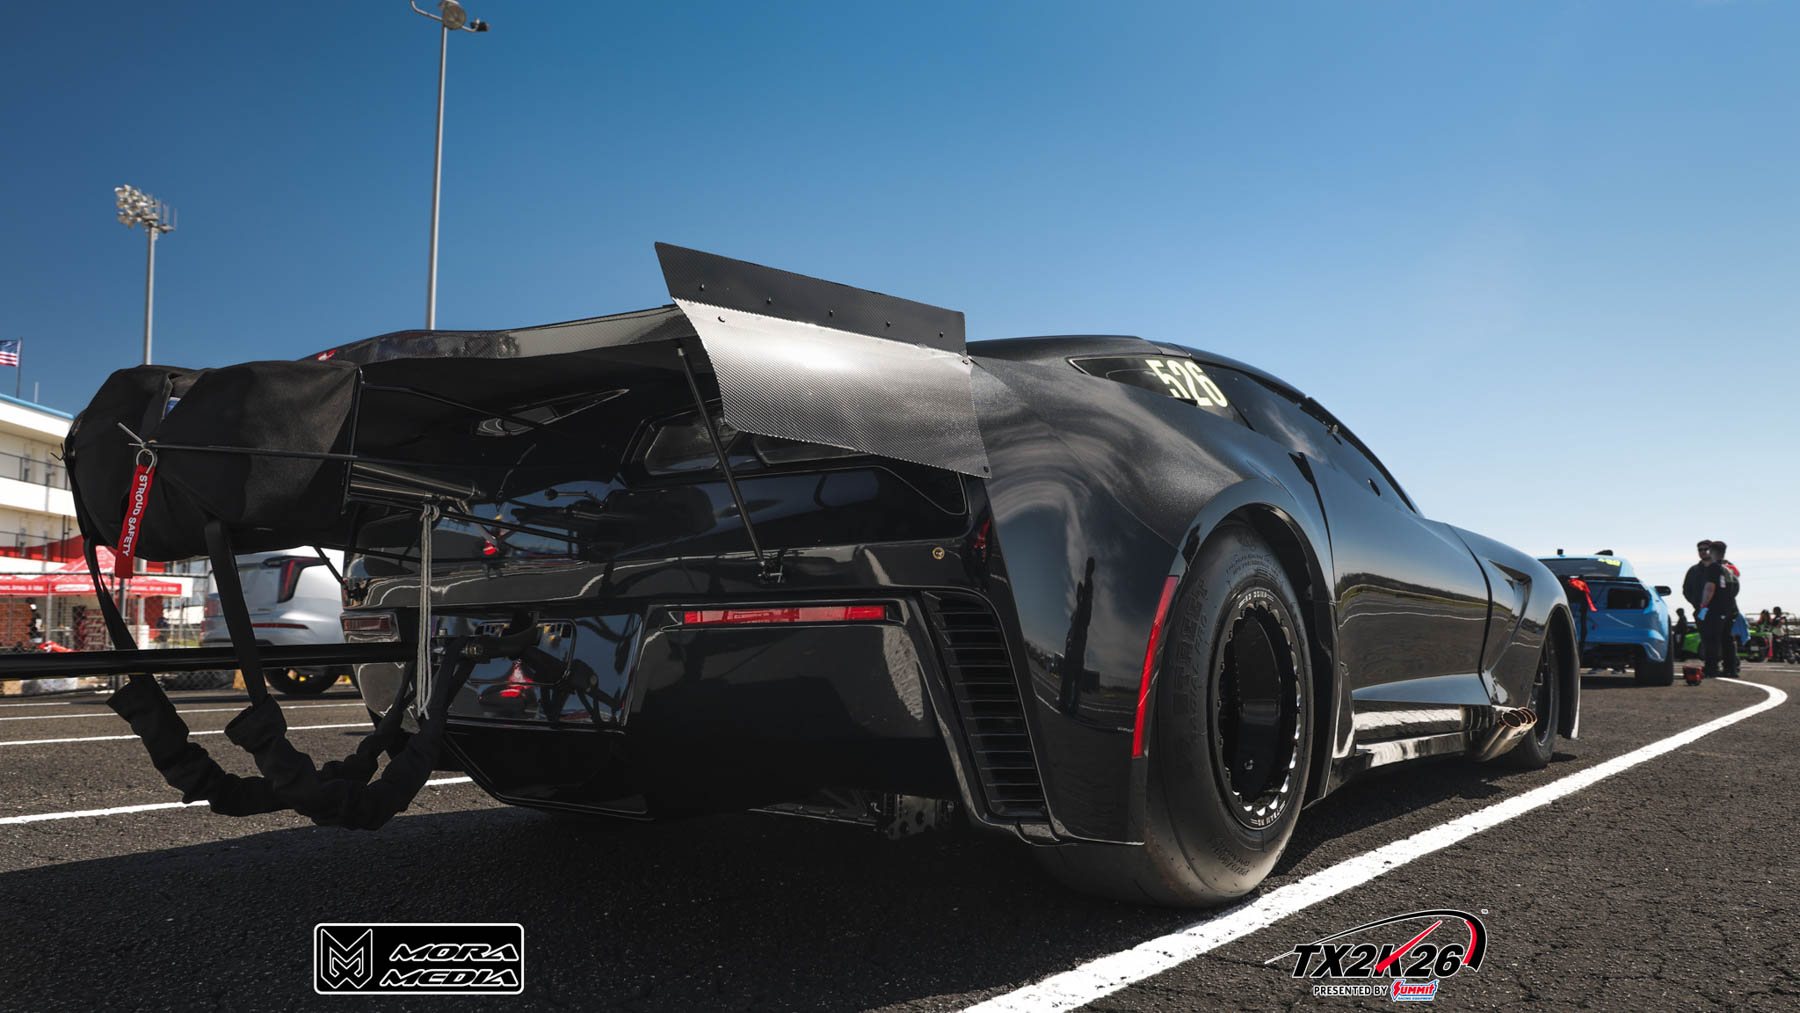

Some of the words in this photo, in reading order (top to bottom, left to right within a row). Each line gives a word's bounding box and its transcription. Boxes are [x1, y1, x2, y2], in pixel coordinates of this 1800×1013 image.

[1145, 359, 1228, 408] 526
[132, 474, 148, 515] STROUD
[122, 517, 137, 556] SAFETY
